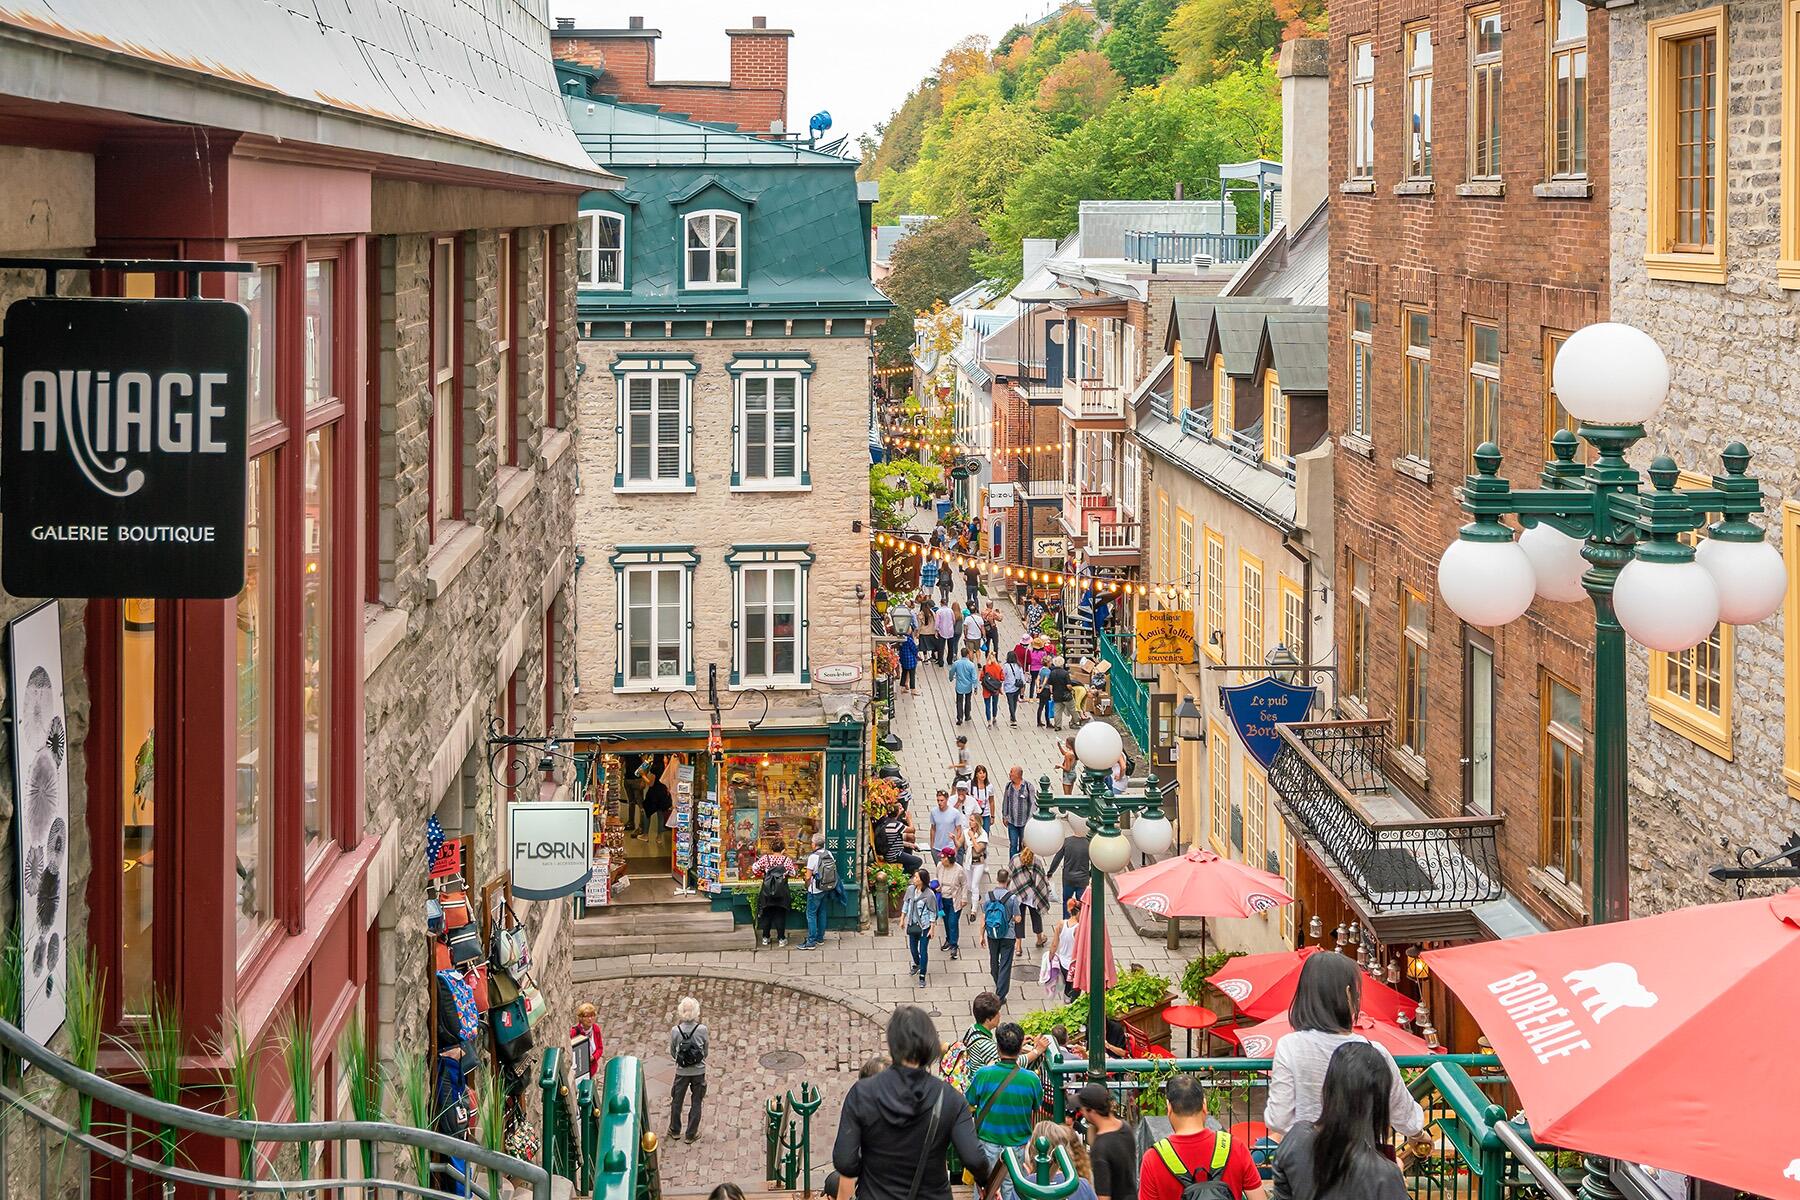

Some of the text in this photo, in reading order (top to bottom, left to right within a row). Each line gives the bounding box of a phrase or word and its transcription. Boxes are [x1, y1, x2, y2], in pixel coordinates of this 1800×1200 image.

[31, 526, 215, 543] GALERIE BOUTIQUE
[1149, 613, 1182, 623] boutique
[1138, 626, 1166, 642] Louis
[1147, 654, 1184, 662] souvenirs
[1250, 694, 1288, 708] Le pub
[1260, 709, 1278, 721] des
[1246, 723, 1279, 740] Borg
[516, 841, 585, 859] FLORIN
